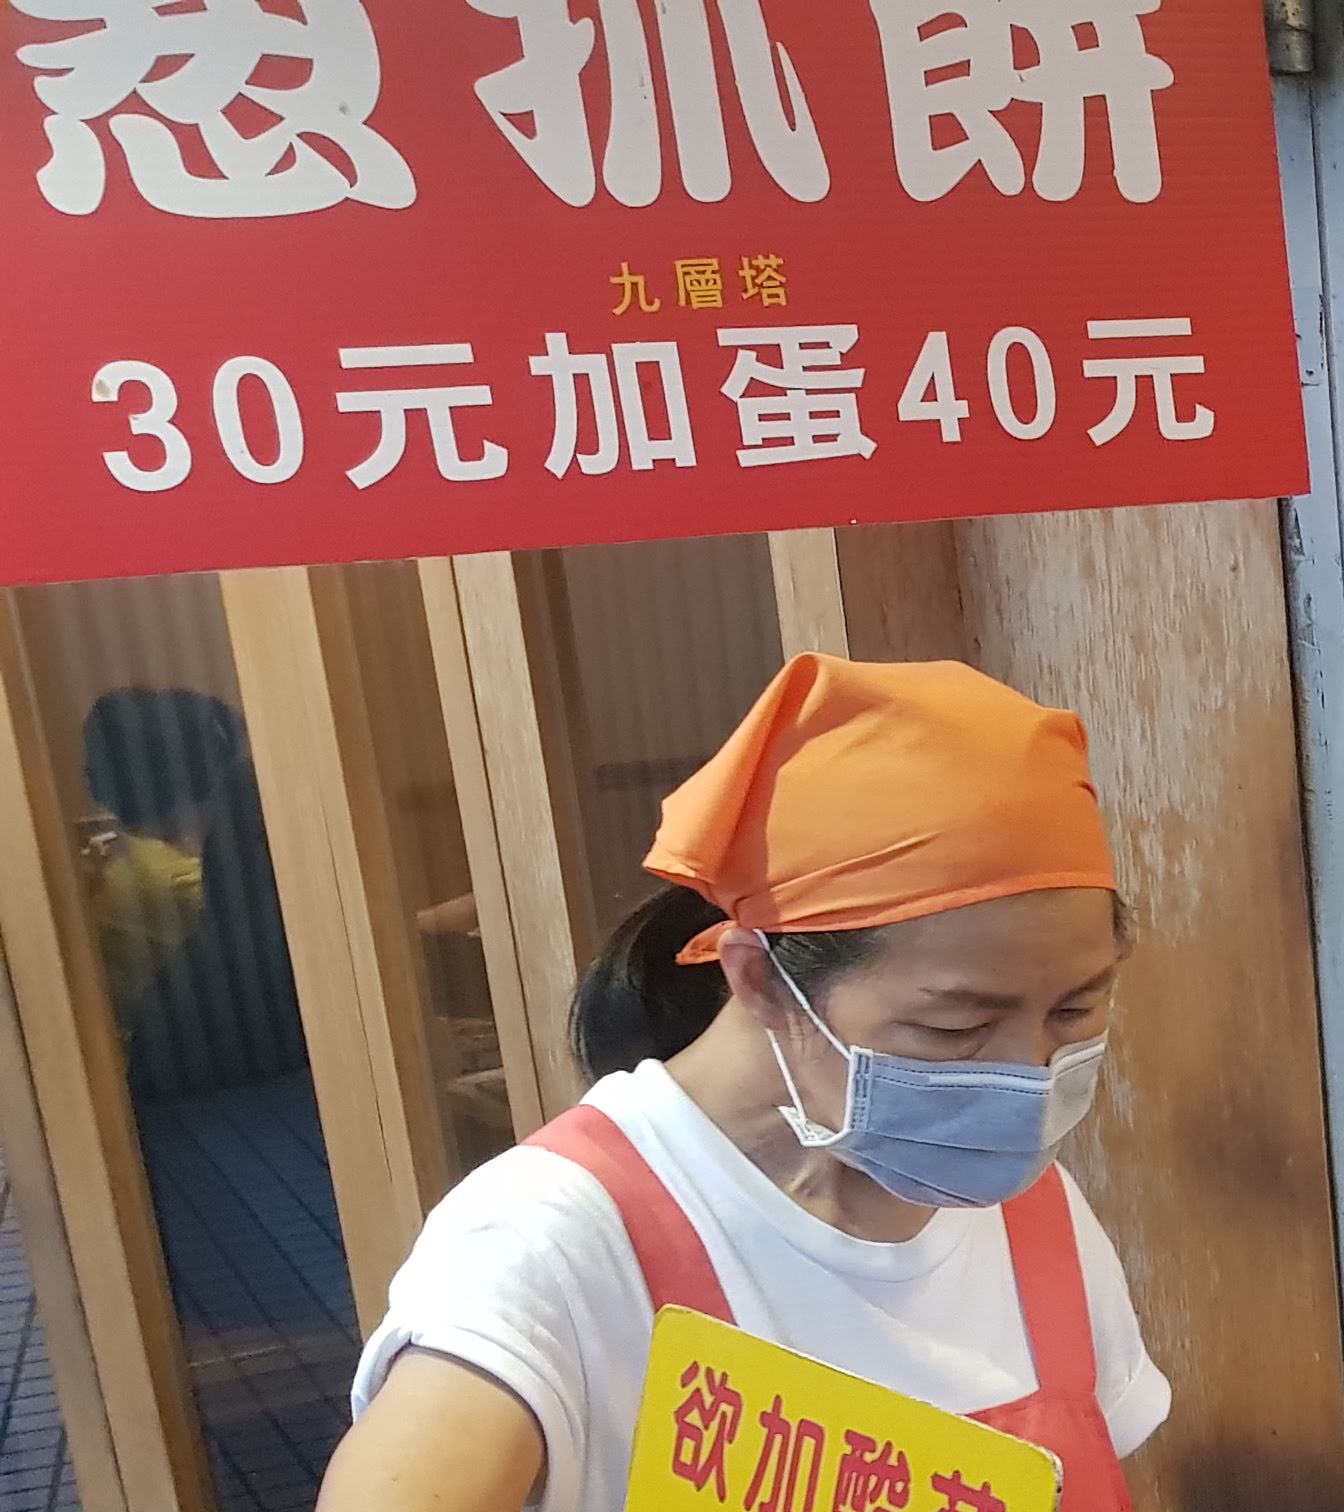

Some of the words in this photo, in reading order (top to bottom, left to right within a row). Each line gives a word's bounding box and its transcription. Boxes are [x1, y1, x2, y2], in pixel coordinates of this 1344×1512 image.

[610, 253, 789, 317] 九層塔
[92, 316, 1216, 494] 30元加蛋40元
